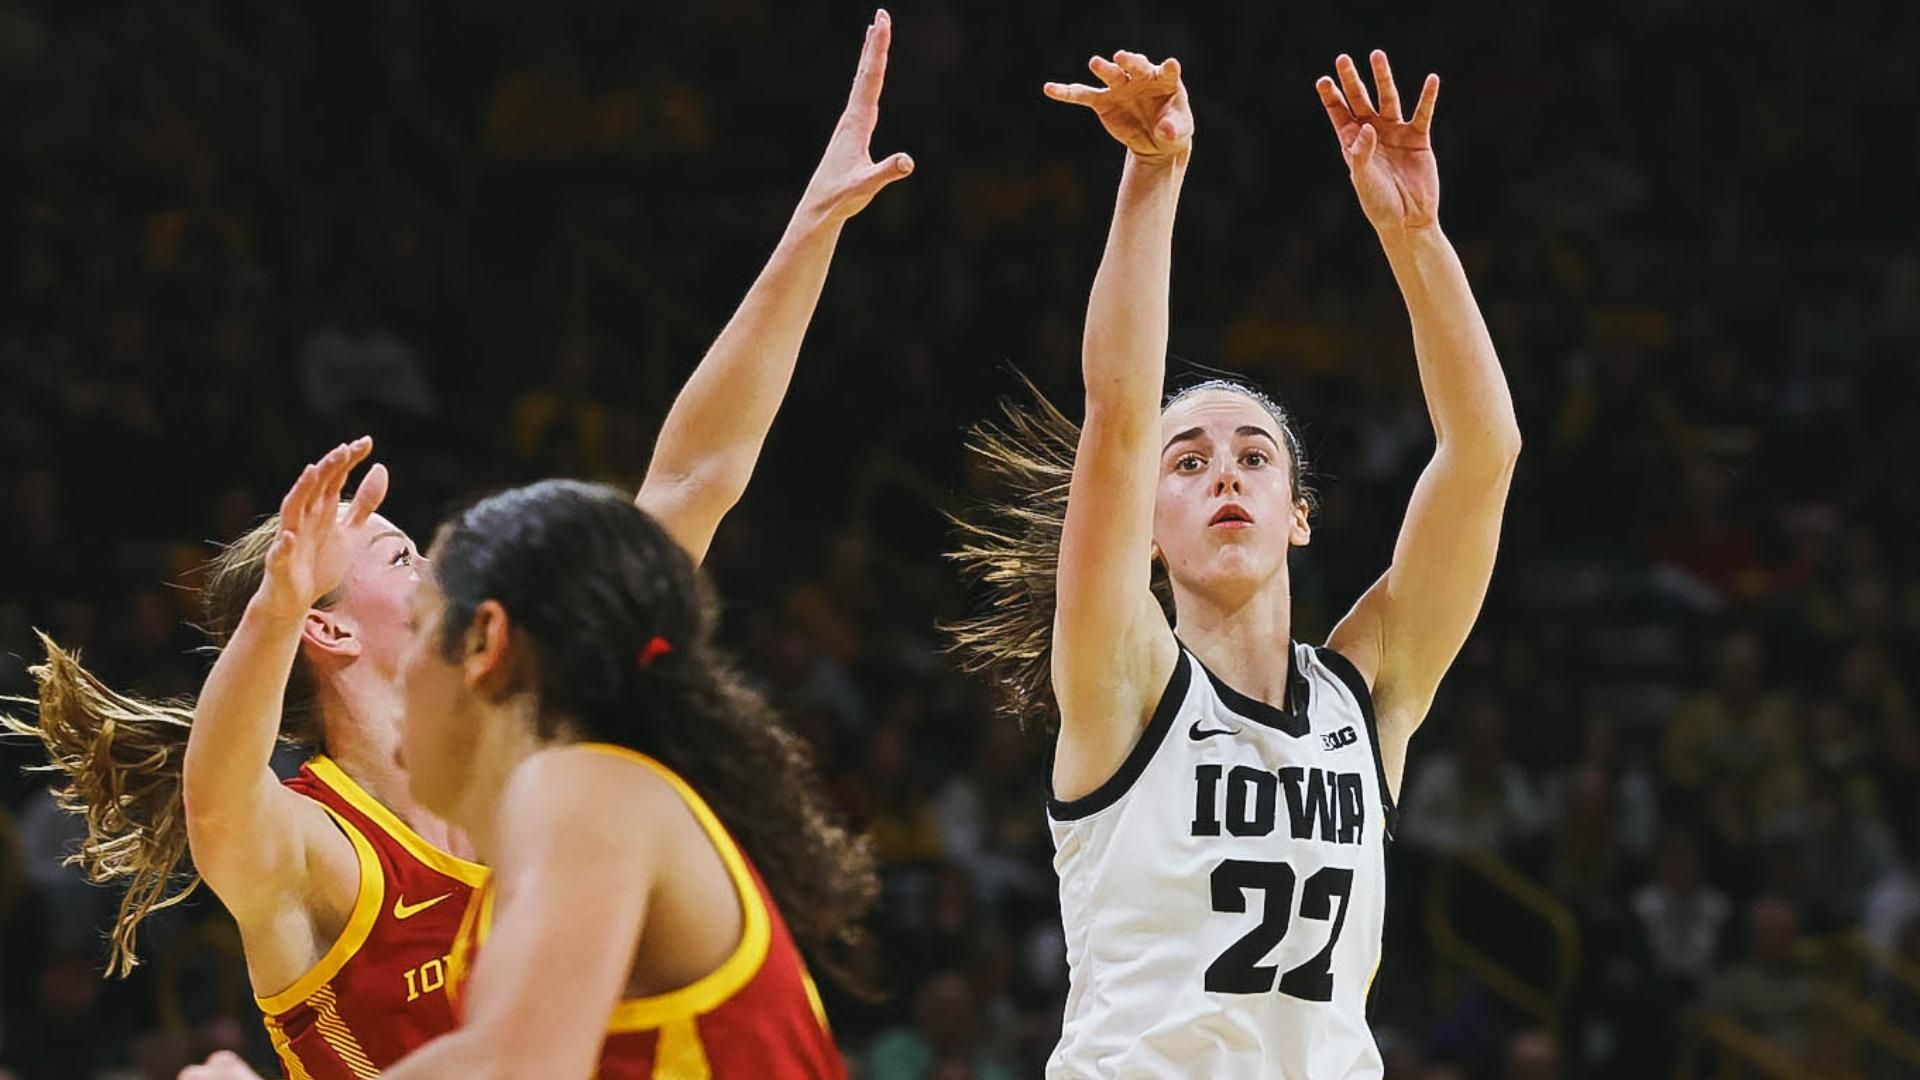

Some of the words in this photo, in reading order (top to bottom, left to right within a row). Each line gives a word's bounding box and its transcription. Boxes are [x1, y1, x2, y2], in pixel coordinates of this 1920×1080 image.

[1191, 764, 1364, 845] IOWA
[1204, 859, 1354, 1002] 22
[404, 954, 452, 1002] IO
